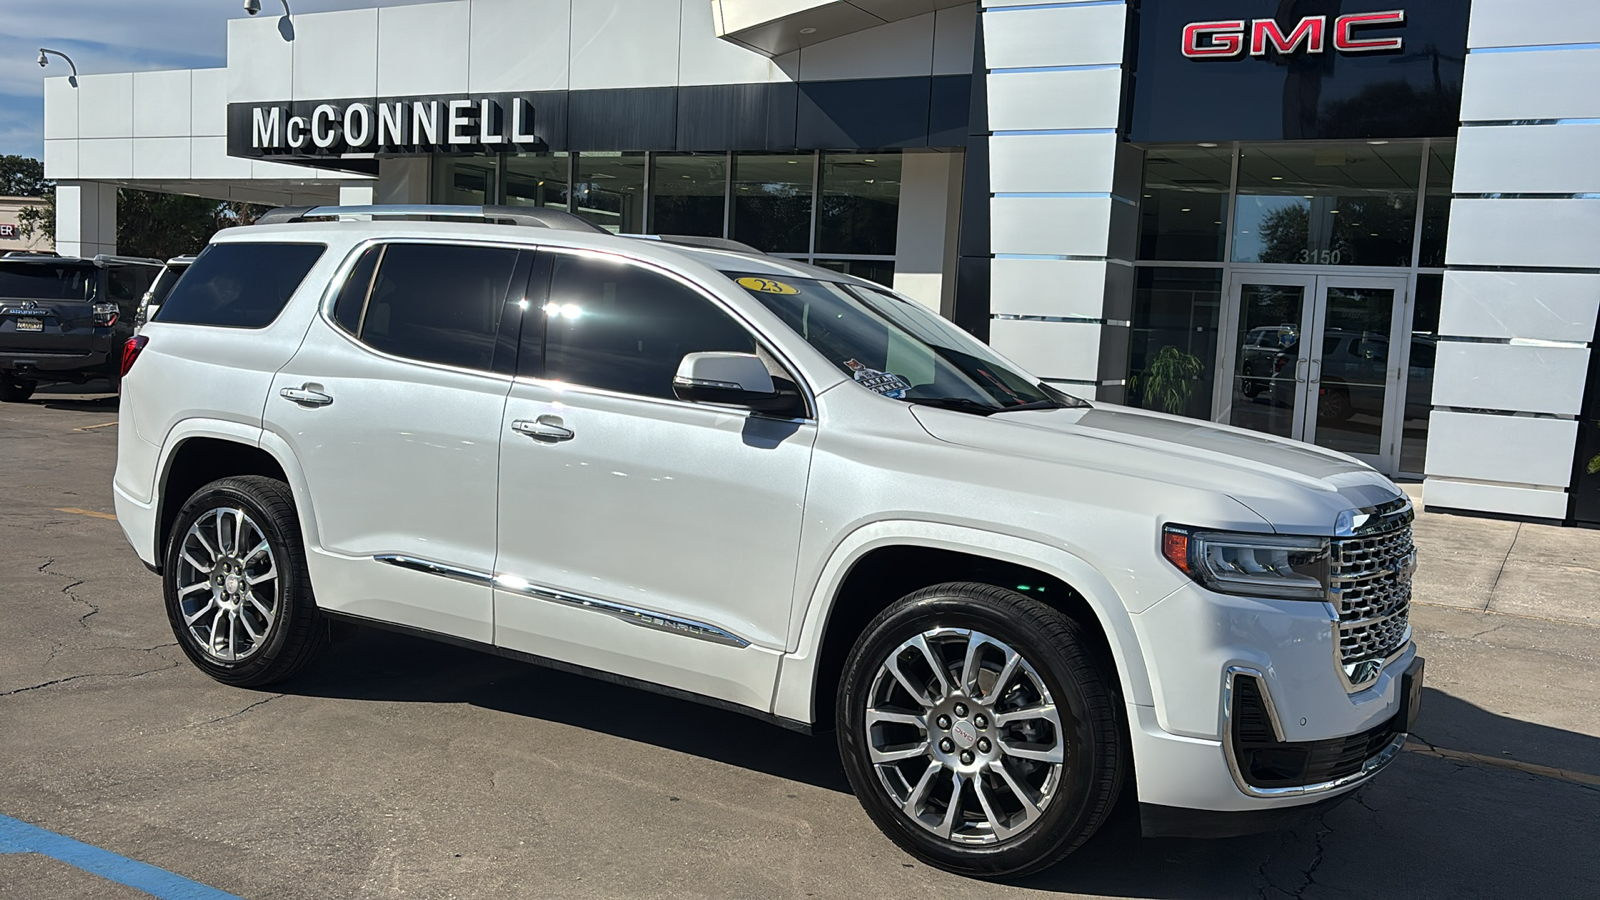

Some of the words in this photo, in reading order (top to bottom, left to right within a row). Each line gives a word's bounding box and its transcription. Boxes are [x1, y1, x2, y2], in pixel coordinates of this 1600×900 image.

[1181, 9, 1405, 58] GMC
[252, 98, 534, 149] McCONNELL
[1300, 248, 1341, 265] 3150
[754, 278, 783, 292] 23
[641, 614, 704, 635] DENALI
